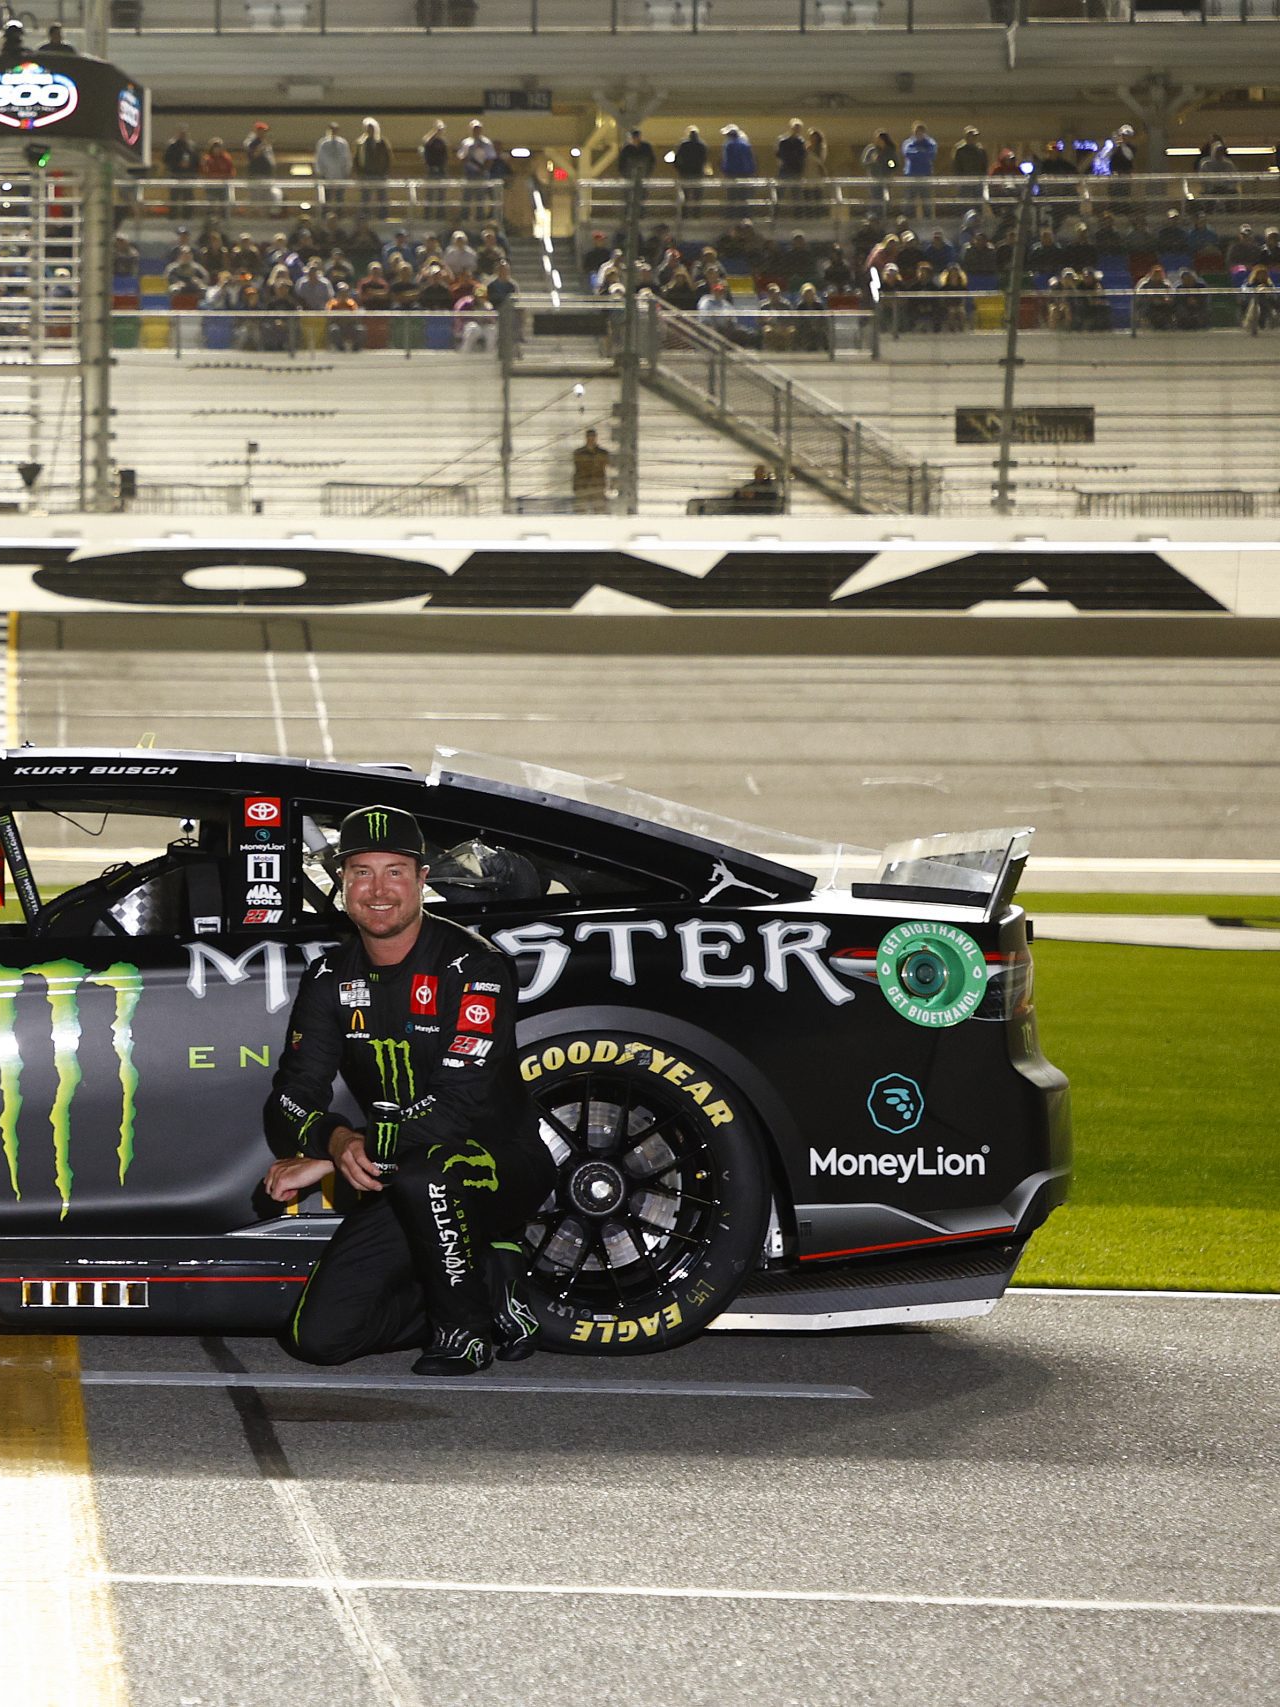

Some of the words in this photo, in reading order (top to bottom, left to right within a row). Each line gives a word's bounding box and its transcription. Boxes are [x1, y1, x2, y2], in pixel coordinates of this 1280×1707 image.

[14, 766, 84, 775] KURT
[90, 766, 179, 775] BUSCH
[259, 862, 267, 878] 1
[246, 883, 282, 900] MAC
[882, 932, 902, 956] GET
[900, 923, 978, 962] BIOETHANOL
[887, 985, 909, 1009] GET
[907, 990, 980, 1024] BIOETHANOL
[428, 1182, 467, 1287] MONSTER
[570, 1301, 683, 1344] EAGLE
